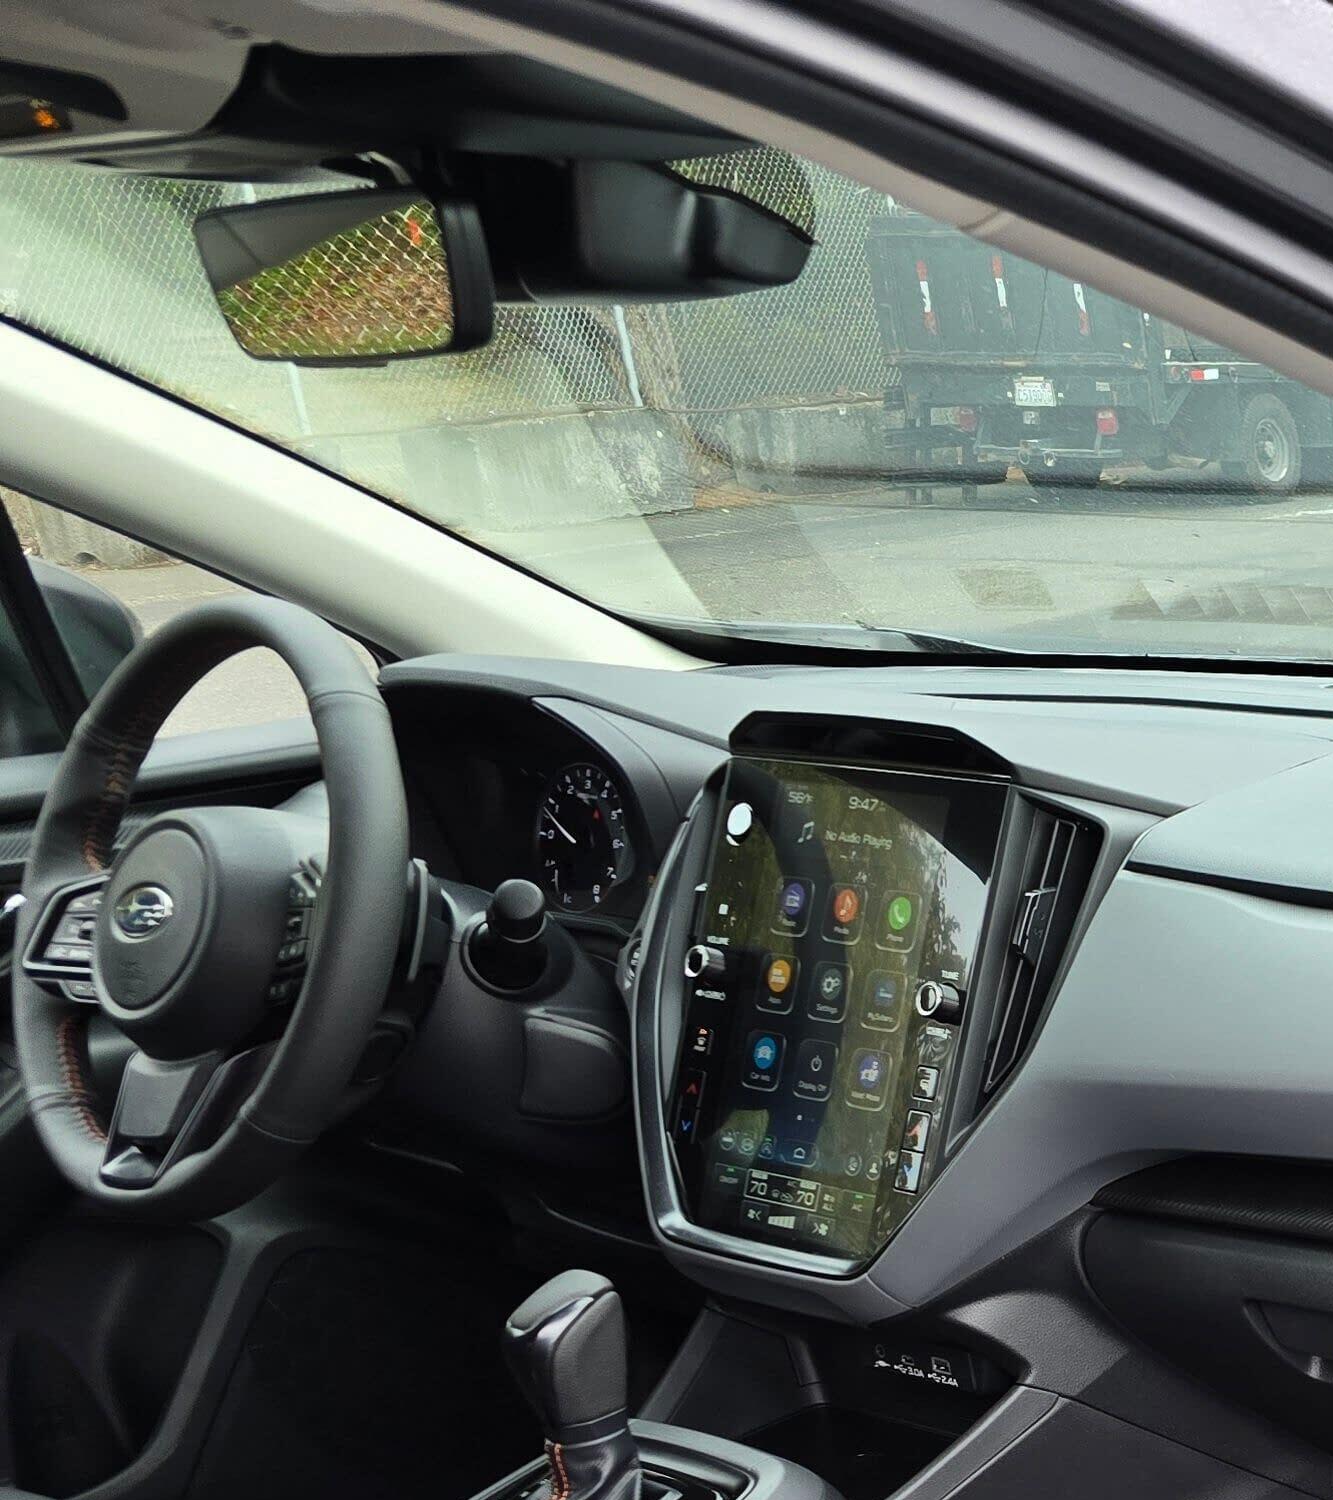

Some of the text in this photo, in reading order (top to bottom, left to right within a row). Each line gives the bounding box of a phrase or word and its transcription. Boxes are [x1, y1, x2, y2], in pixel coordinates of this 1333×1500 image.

[848, 796, 879, 811] 9:47
[750, 1180, 768, 1196] 70
[796, 1190, 815, 1206] 70
